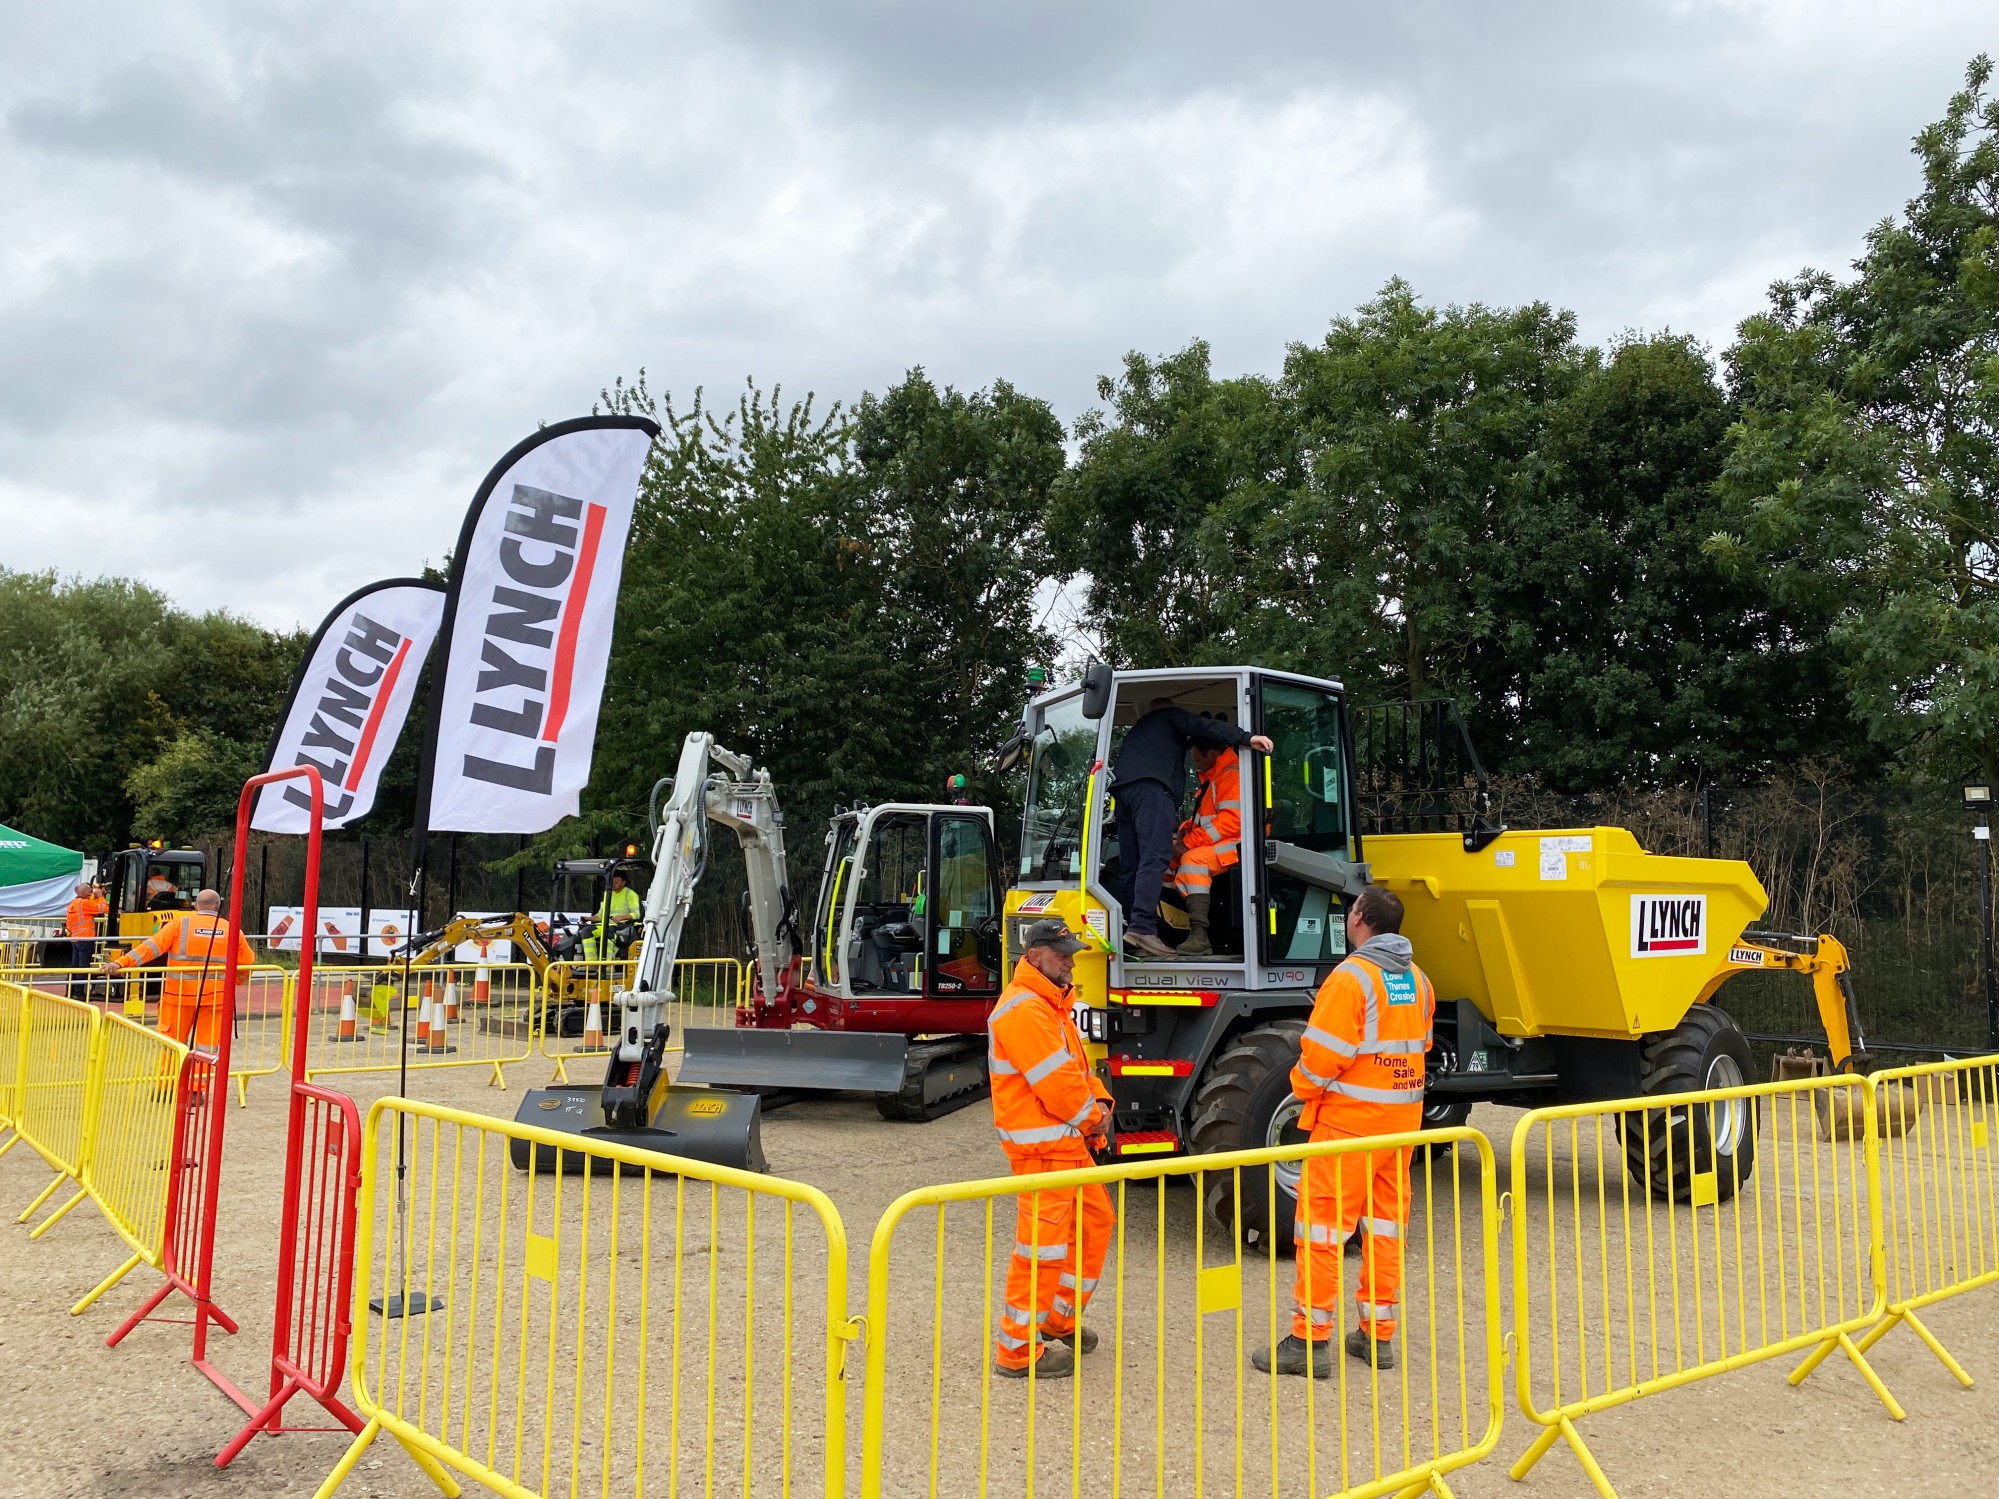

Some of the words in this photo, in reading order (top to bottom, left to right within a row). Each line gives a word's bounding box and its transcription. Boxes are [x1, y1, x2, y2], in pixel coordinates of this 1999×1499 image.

[1134, 975, 1177, 986] dual
[1185, 975, 1229, 987] view
[1267, 971, 1305, 983] DV90
[1374, 1053, 1408, 1067] home
[1392, 1082, 1408, 1090] and
[1409, 1075, 1424, 1089] wel
